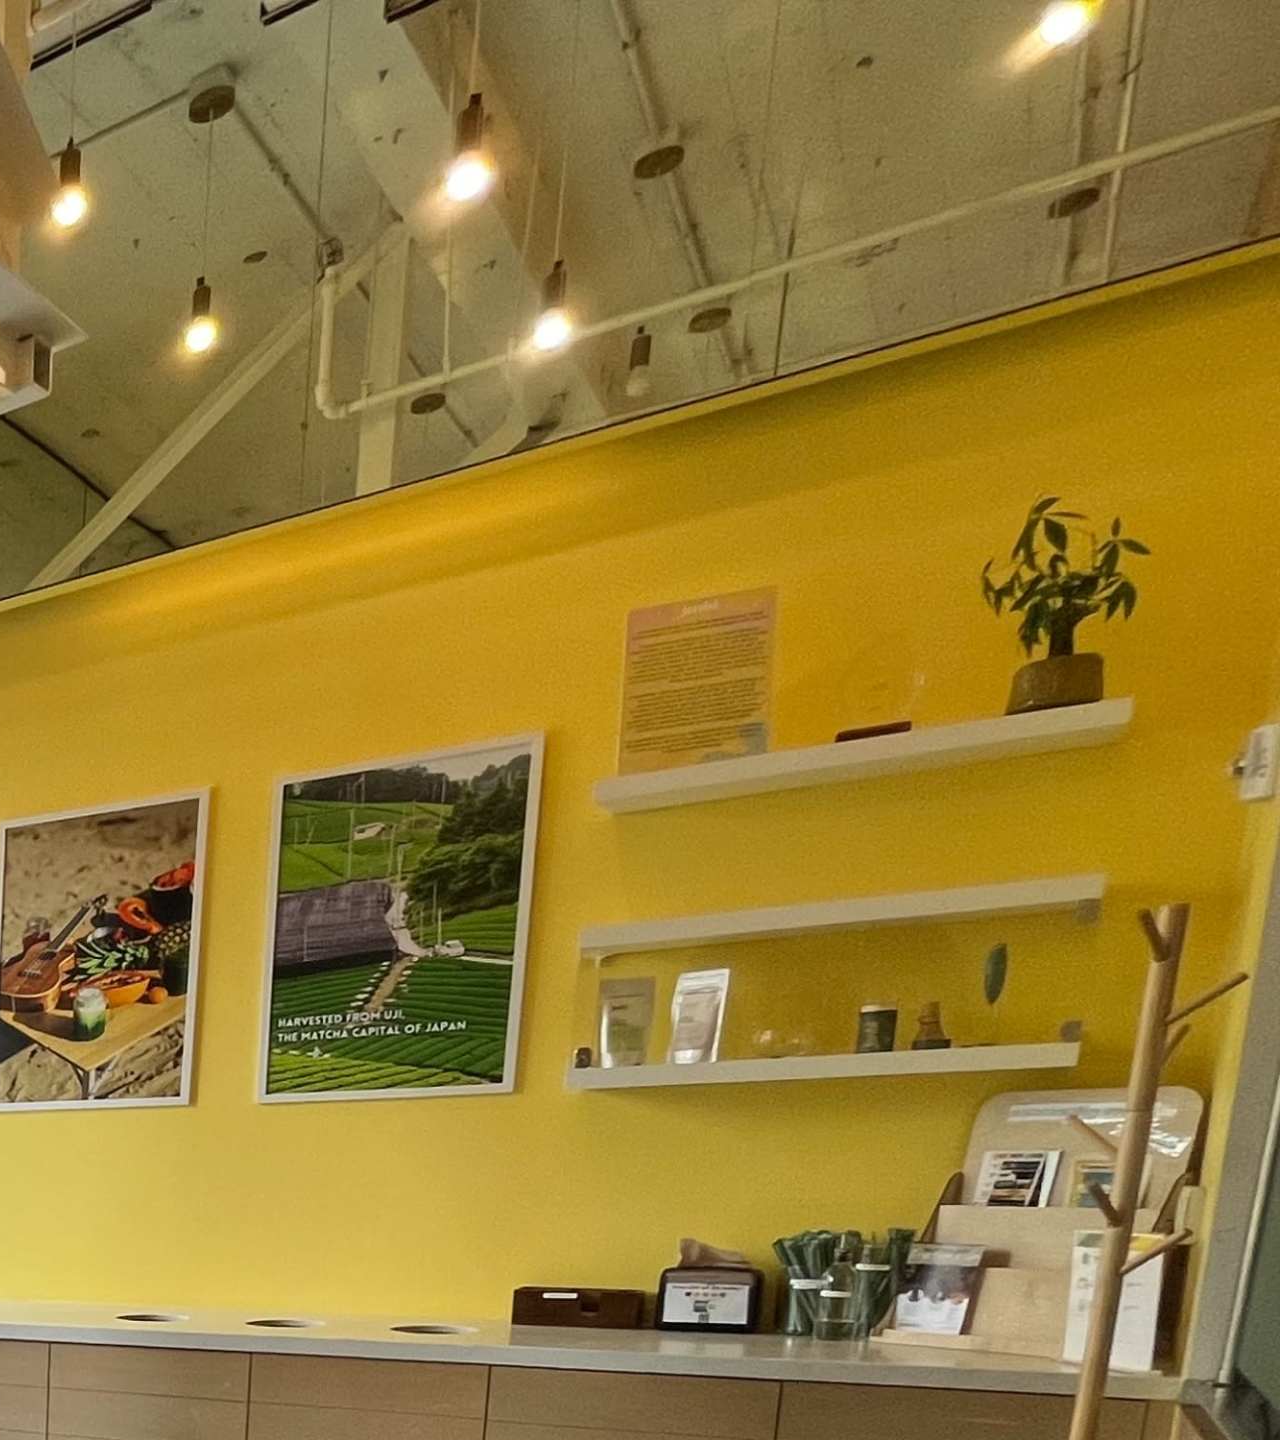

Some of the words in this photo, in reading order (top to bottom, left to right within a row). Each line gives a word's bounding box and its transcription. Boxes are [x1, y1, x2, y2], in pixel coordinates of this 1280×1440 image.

[277, 1013, 341, 1028] HARVESTED
[346, 1010, 381, 1024] FROM
[277, 1032, 297, 1043] THE
[300, 1028, 349, 1042] MATCHA
[351, 1025, 401, 1038] CAPITAL
[404, 1022, 422, 1034] OF
[424, 1020, 467, 1033] JAPAN
